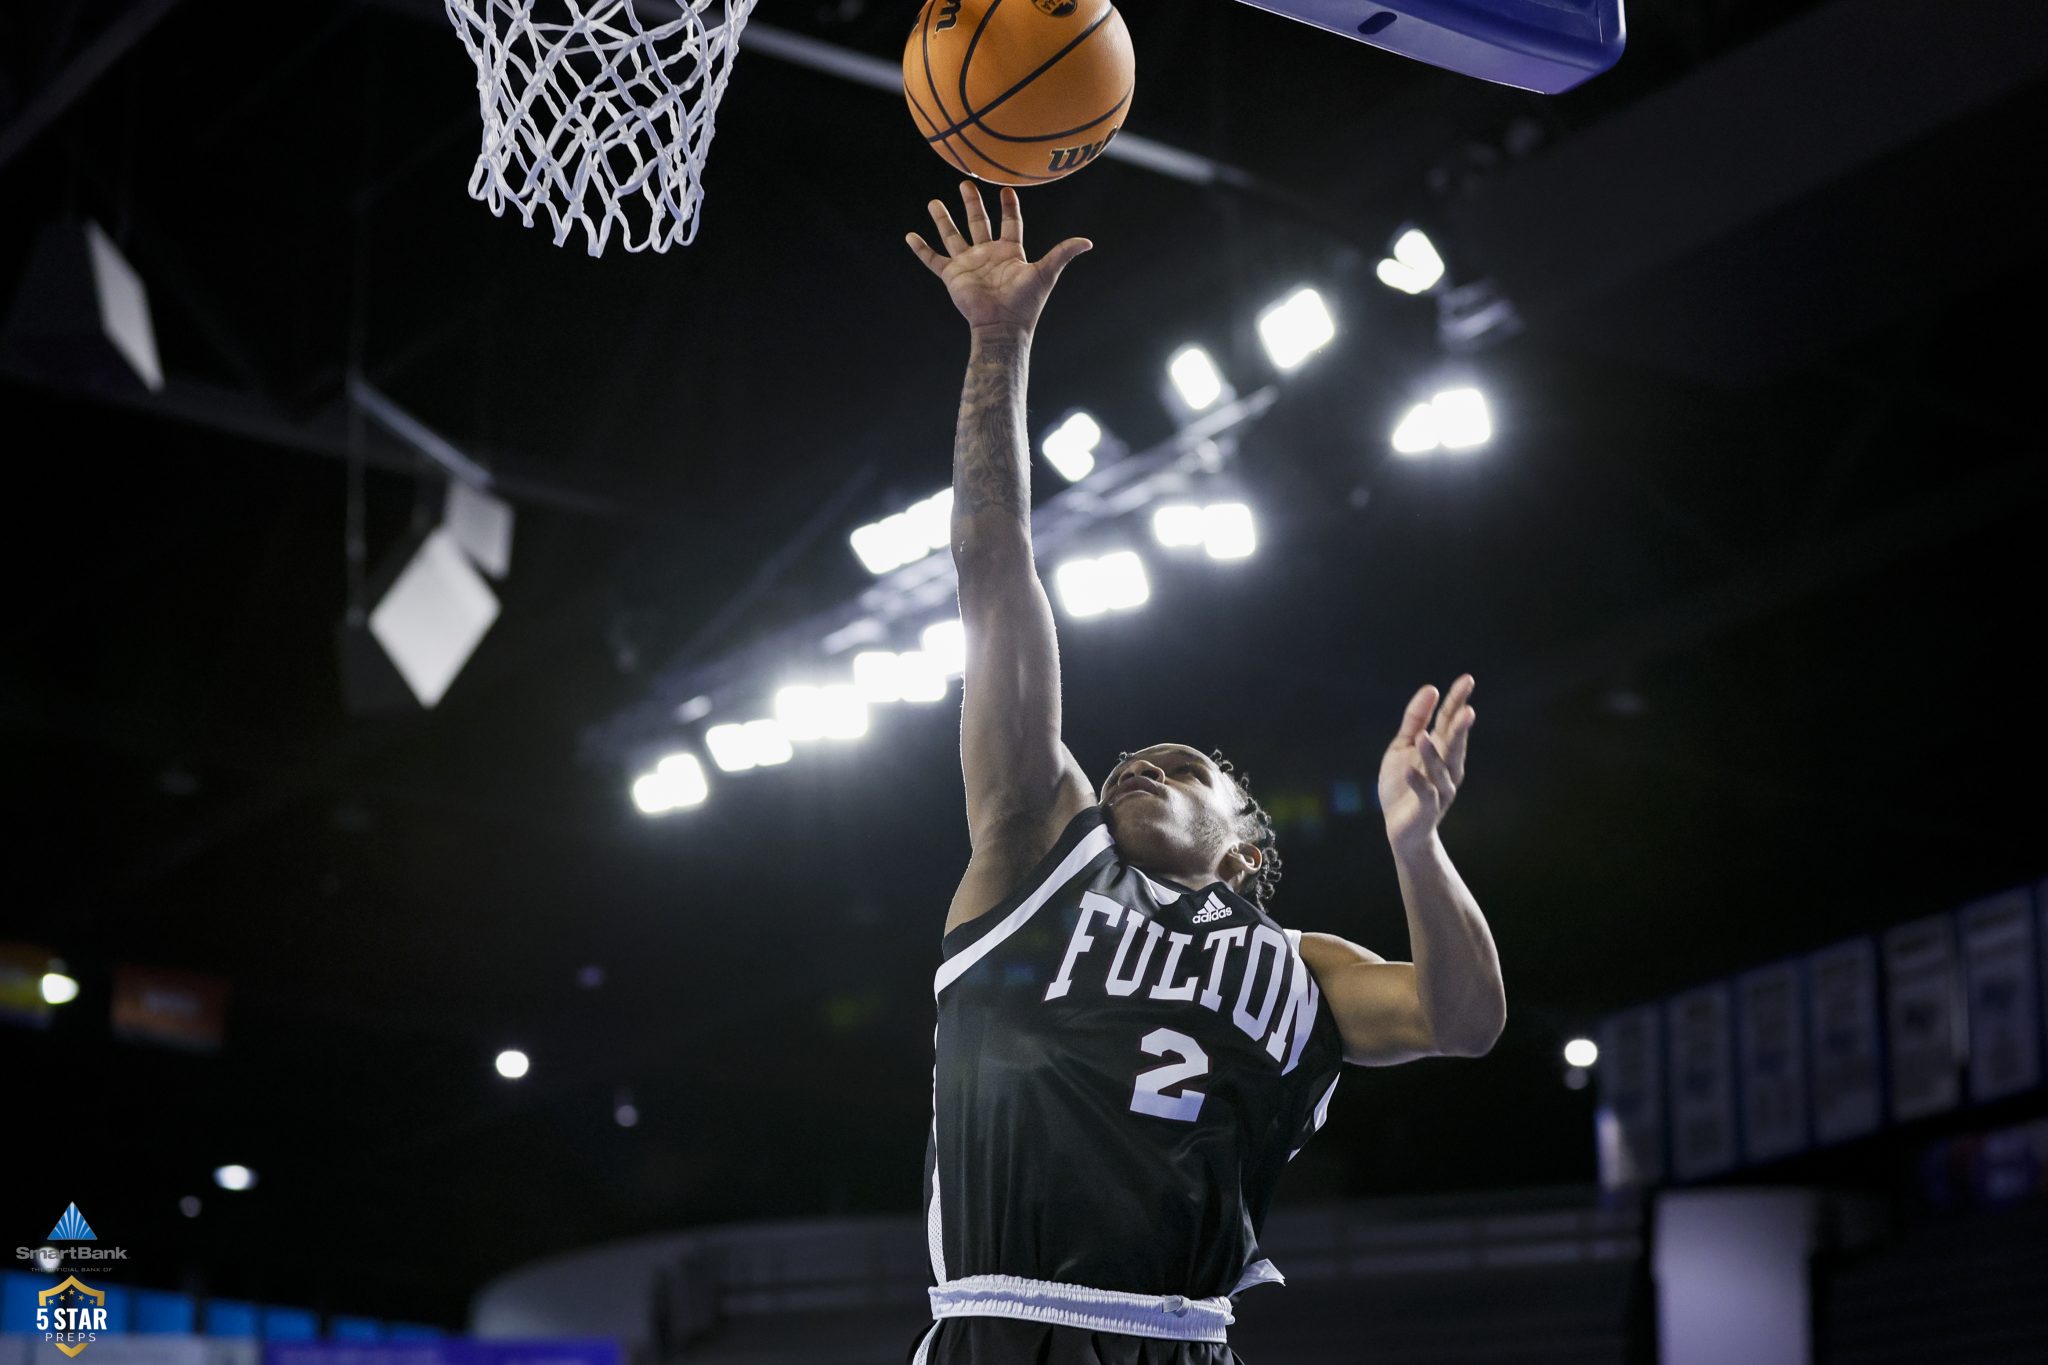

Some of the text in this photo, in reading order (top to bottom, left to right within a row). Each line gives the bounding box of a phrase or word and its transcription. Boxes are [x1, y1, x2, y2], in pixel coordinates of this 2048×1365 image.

[1192, 906, 1233, 924] adidas
[1044, 891, 1320, 1077] FULTON
[1129, 1027, 1209, 1122] 2
